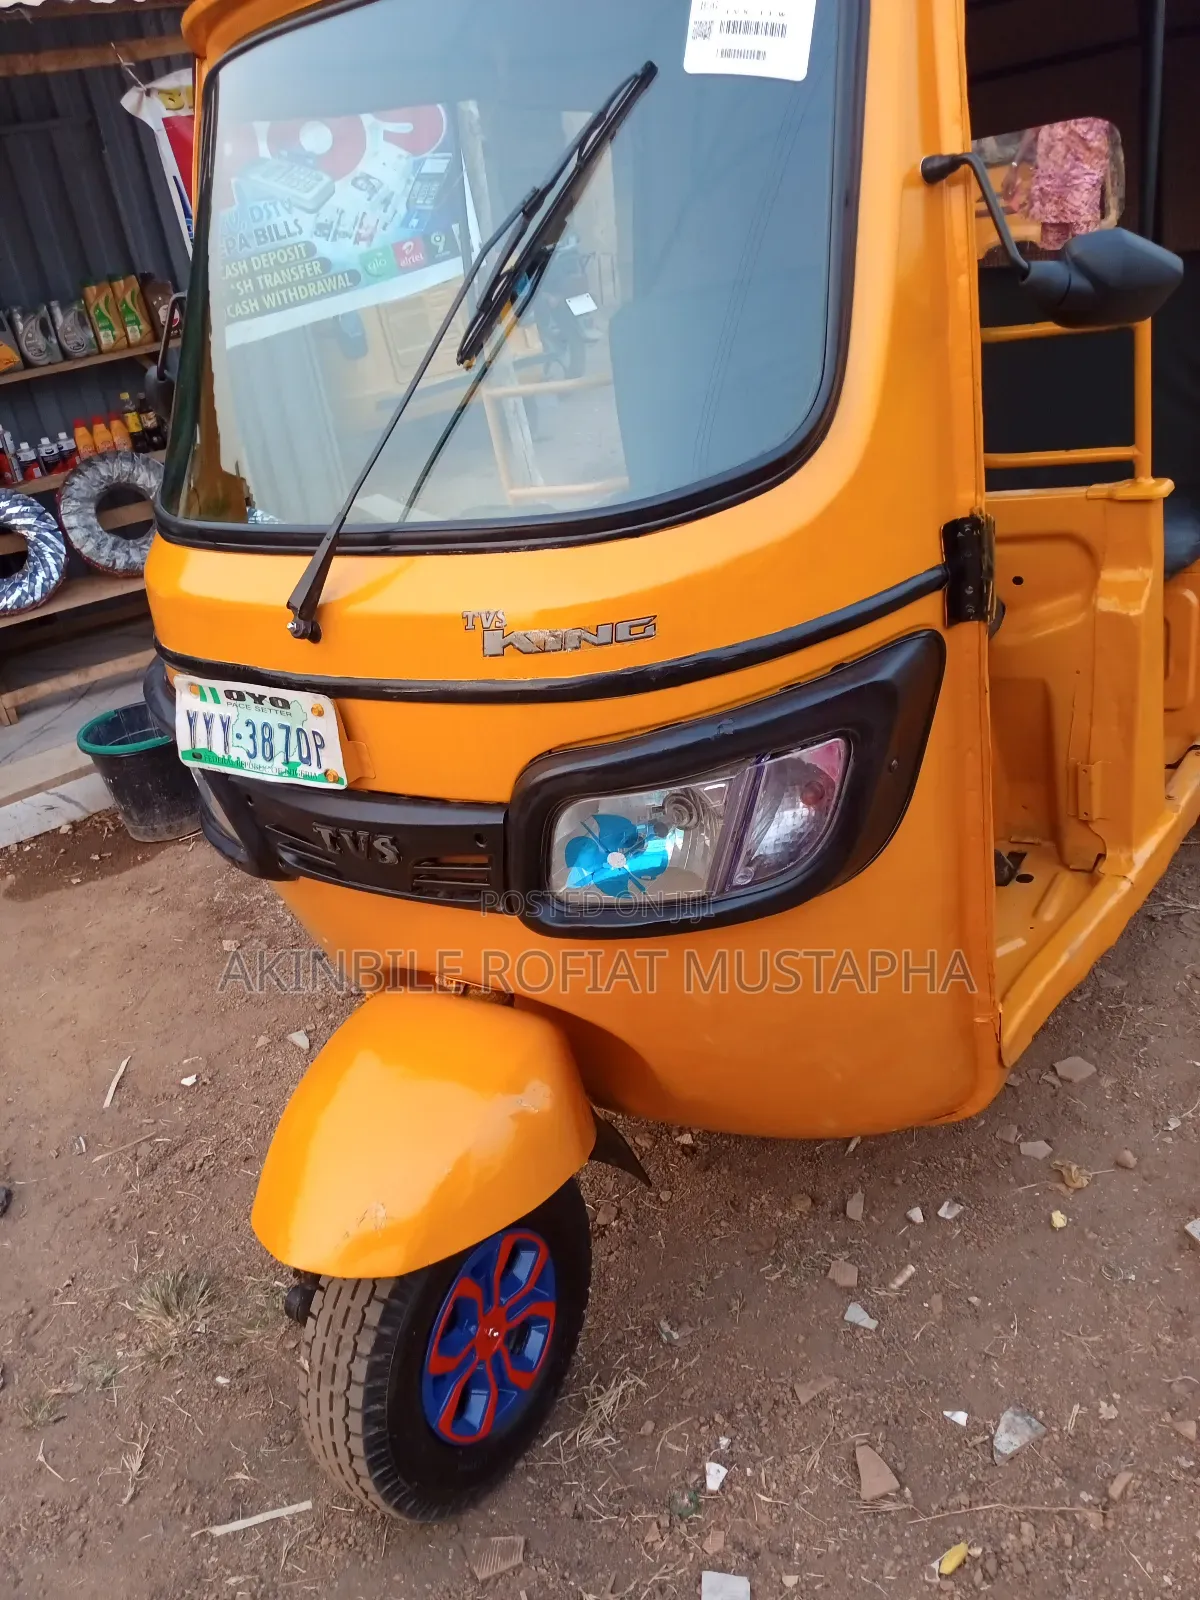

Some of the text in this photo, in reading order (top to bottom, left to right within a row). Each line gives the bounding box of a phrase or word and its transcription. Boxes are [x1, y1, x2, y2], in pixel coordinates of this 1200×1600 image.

[254, 218, 304, 247] BILLS
[251, 242, 307, 271] DEPOSIT
[400, 252, 425, 268] airtel
[257, 260, 323, 291] TRANSFER
[226, 273, 354, 318] CASH WITHDRAWAL
[462, 609, 507, 630] TVS
[482, 614, 658, 657] KING
[223, 689, 292, 710] OYO
[226, 701, 293, 718] PACE SETTER
[312, 821, 403, 865] TVS
